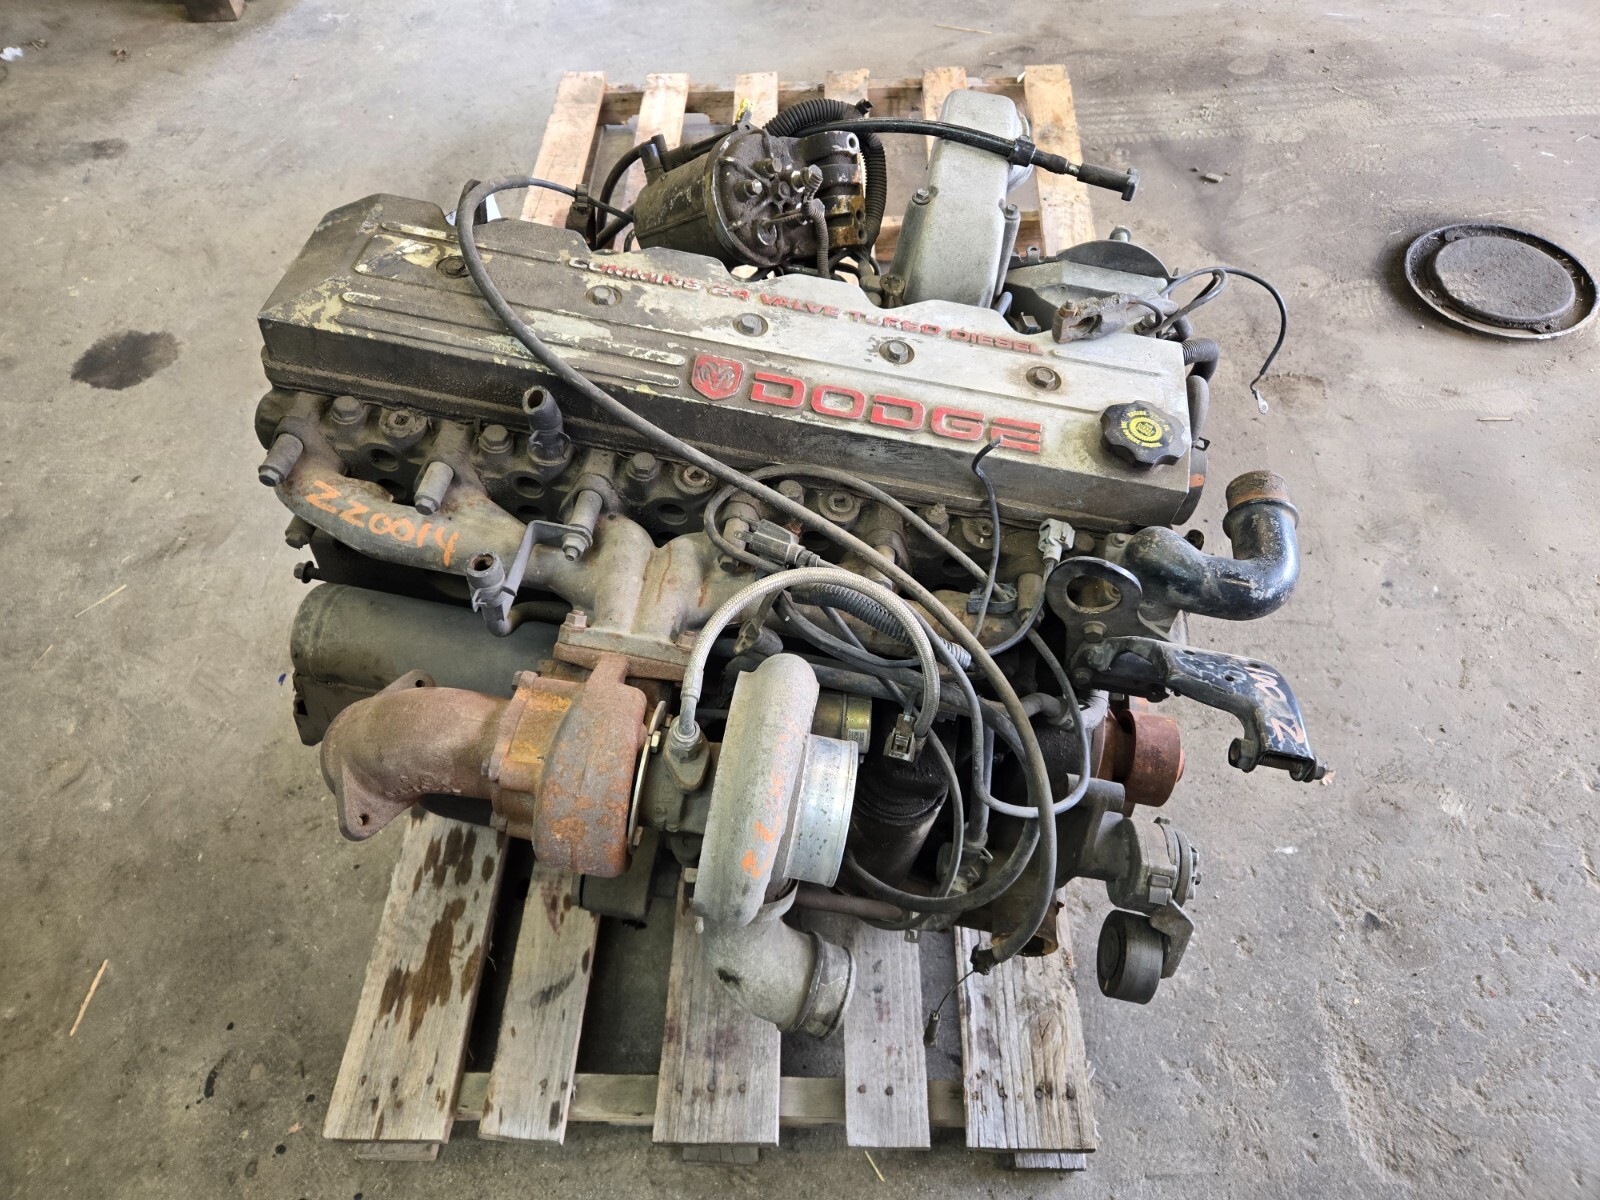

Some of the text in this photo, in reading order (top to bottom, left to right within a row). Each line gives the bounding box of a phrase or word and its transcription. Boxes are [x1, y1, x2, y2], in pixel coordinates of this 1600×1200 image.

[568, 257, 1044, 357] CUMMINS 24 VALVE TURBO DIESEL
[749, 371, 1043, 454] DODGE
